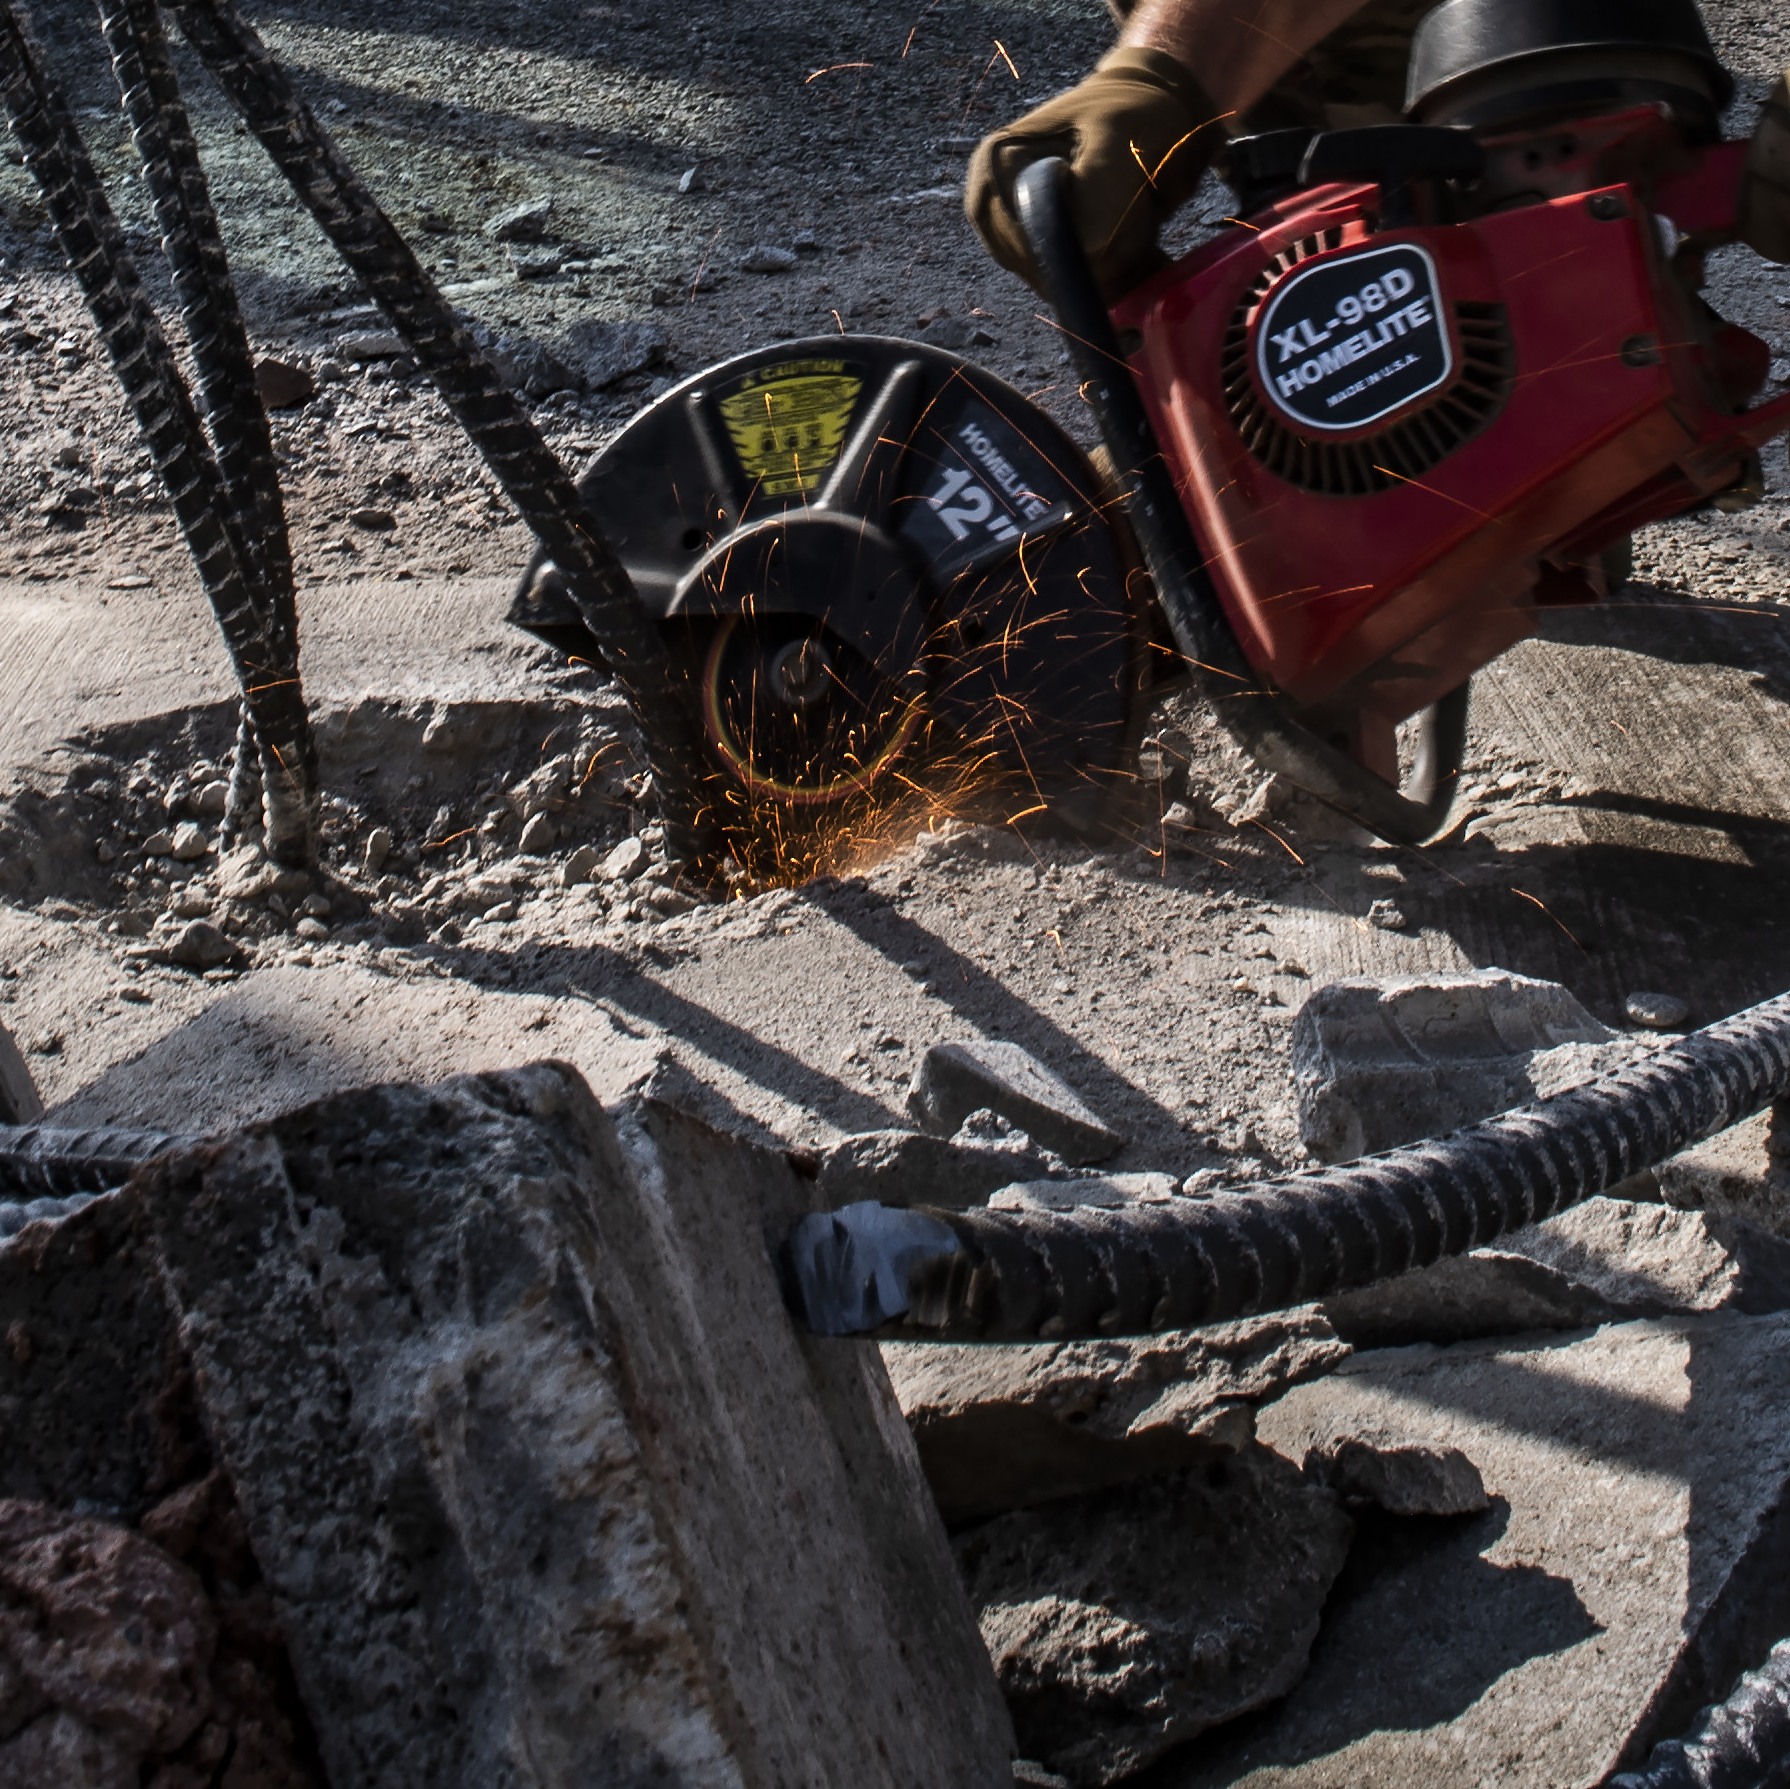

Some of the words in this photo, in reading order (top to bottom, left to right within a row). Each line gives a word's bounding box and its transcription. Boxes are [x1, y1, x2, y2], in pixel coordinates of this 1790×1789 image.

[1269, 267, 1415, 364] XL-98D
[1275, 295, 1434, 399] HOMELITE
[1325, 379, 1367, 408] MADE
[1366, 370, 1381, 387] IN
[927, 468, 1020, 541] 12"
[958, 422, 1049, 521] HOMELITE
